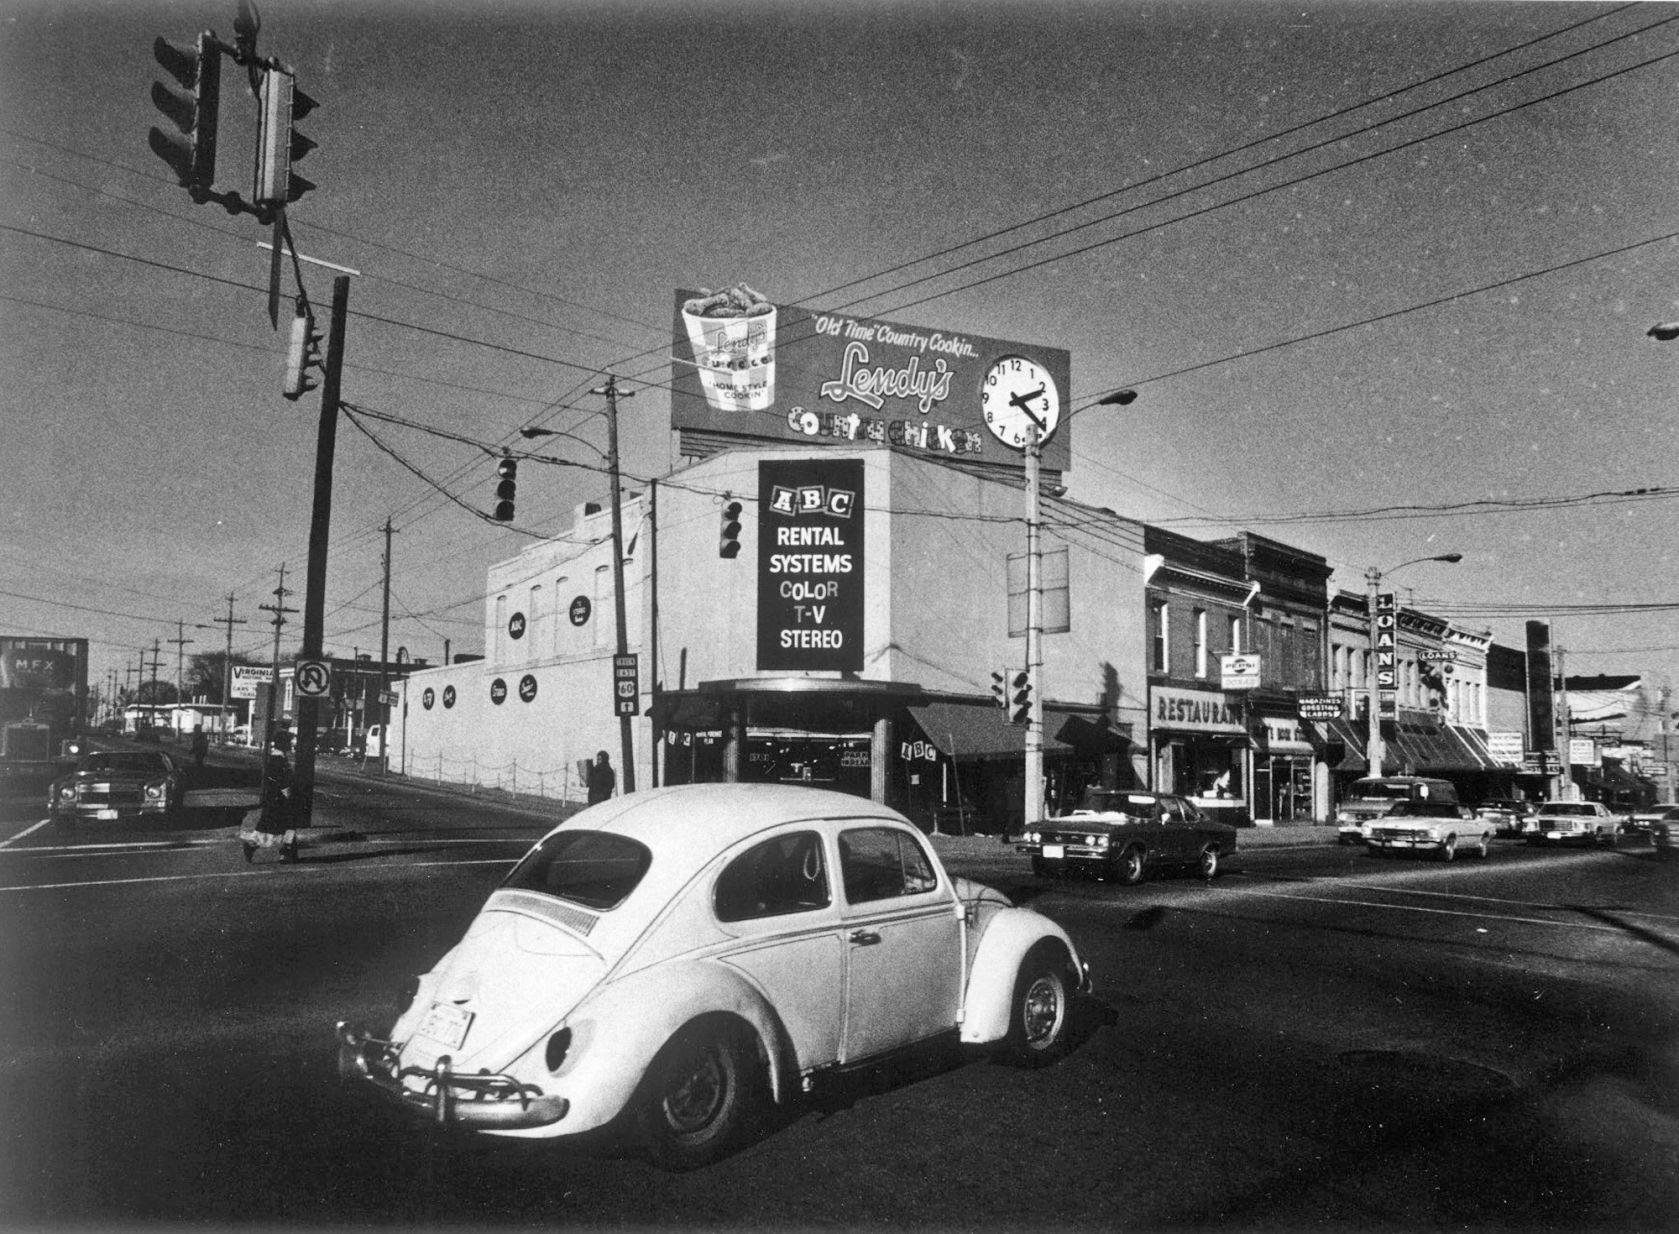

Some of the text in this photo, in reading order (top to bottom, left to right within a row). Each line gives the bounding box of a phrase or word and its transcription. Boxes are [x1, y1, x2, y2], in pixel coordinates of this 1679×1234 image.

[876, 324, 929, 353] Country
[997, 363, 1006, 376] 11
[1011, 360, 1022, 372] 12
[819, 340, 955, 414] Lendy's
[985, 374, 998, 386] 10
[1030, 368, 1036, 379] 1
[1039, 381, 1047, 393] 2
[982, 392, 990, 404] 9
[1042, 398, 1050, 412] 3
[986, 411, 994, 424] 8
[999, 425, 1006, 437] 7
[1013, 433, 1021, 444] 6
[771, 487, 852, 516] ABC
[777, 527, 845, 546] RENTAL
[769, 554, 853, 573] SYSTEMS
[779, 580, 839, 600] COLOR
[794, 605, 826, 624] T-V
[780, 629, 843, 649] STEREO
[1376, 595, 1394, 685] LOANS
[1421, 651, 1456, 660] LOANS
[620, 683, 633, 694] 60
[1307, 710, 1334, 718] CARDS
[901, 740, 936, 762] ABC
